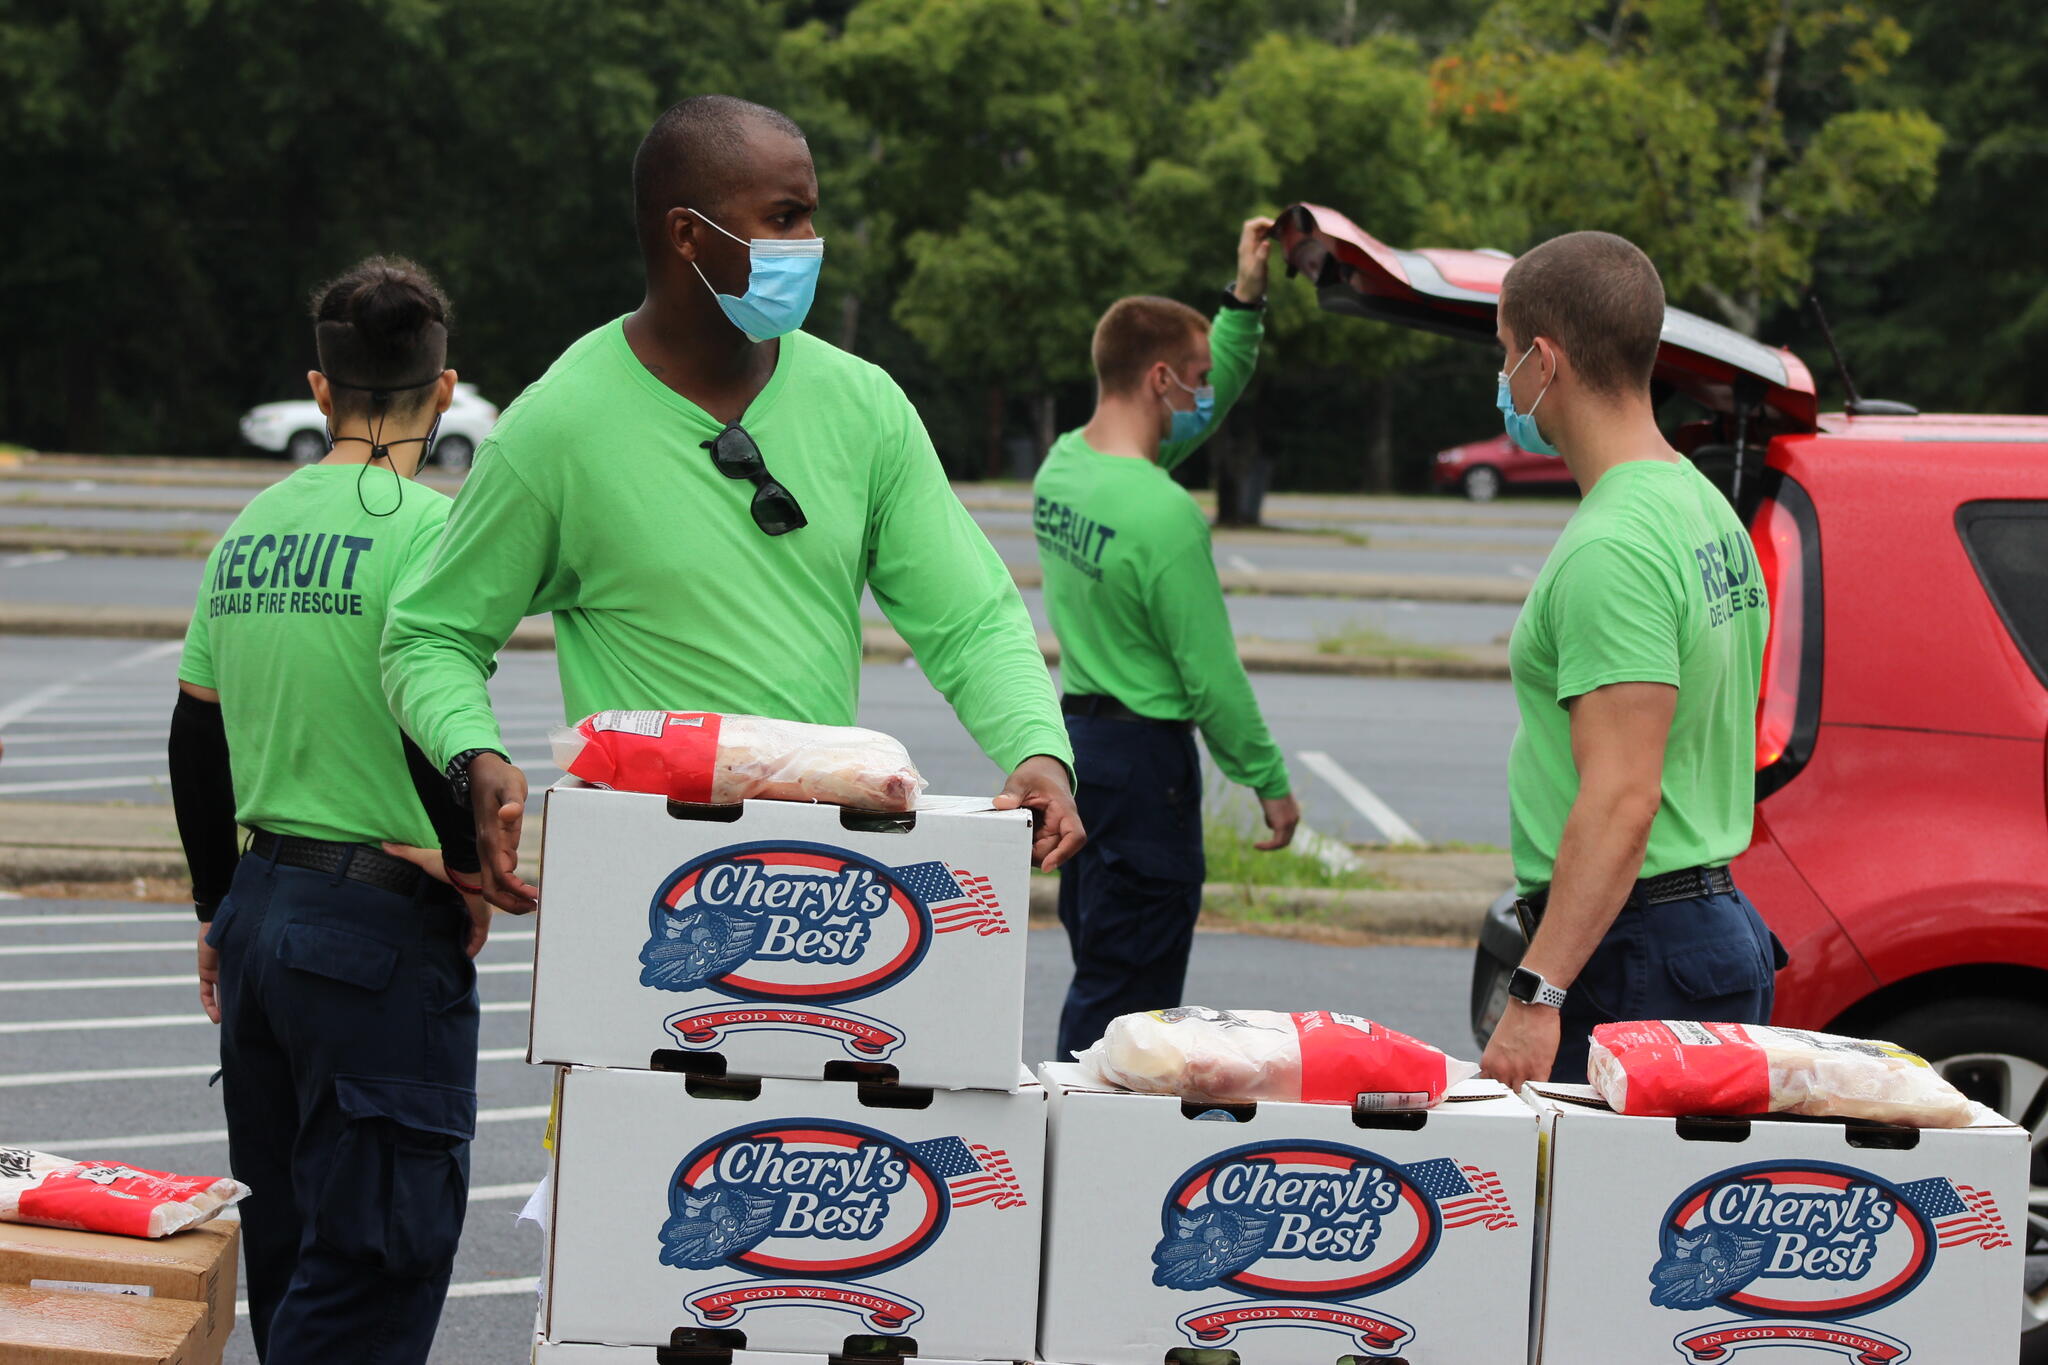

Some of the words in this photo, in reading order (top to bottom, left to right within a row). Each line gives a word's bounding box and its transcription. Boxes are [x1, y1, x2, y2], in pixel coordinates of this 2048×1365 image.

[211, 532, 374, 593] RECRUIT
[209, 592, 251, 619] DEKALB
[256, 591, 286, 614] FIRE
[290, 591, 363, 616] RESCUE
[701, 864, 887, 923] Cheryl's
[755, 915, 865, 959] Best
[692, 1016, 713, 1028] IN
[723, 1012, 768, 1023] GOD
[779, 1013, 808, 1024] WE
[818, 1016, 878, 1039] TRUST
[719, 1142, 904, 1197] Cheryl's
[1211, 1163, 1396, 1217] Cheryl's
[775, 1192, 884, 1235] Best
[1709, 1184, 1893, 1238] Cheryl's
[1267, 1213, 1375, 1256] Best
[1764, 1233, 1871, 1275] Best
[711, 1293, 733, 1305] IN
[743, 1288, 787, 1299] GOD
[798, 1289, 827, 1299] WE
[836, 1291, 897, 1314] TRUST
[1204, 1314, 1226, 1326] IN
[1236, 1309, 1280, 1319] GOD
[1289, 1309, 1319, 1320] WE
[1328, 1312, 1389, 1332] TRUST
[1701, 1335, 1722, 1346] IN
[1733, 1329, 1776, 1340] GOD
[1786, 1329, 1816, 1340] WE
[1825, 1331, 1884, 1353] TRUST
